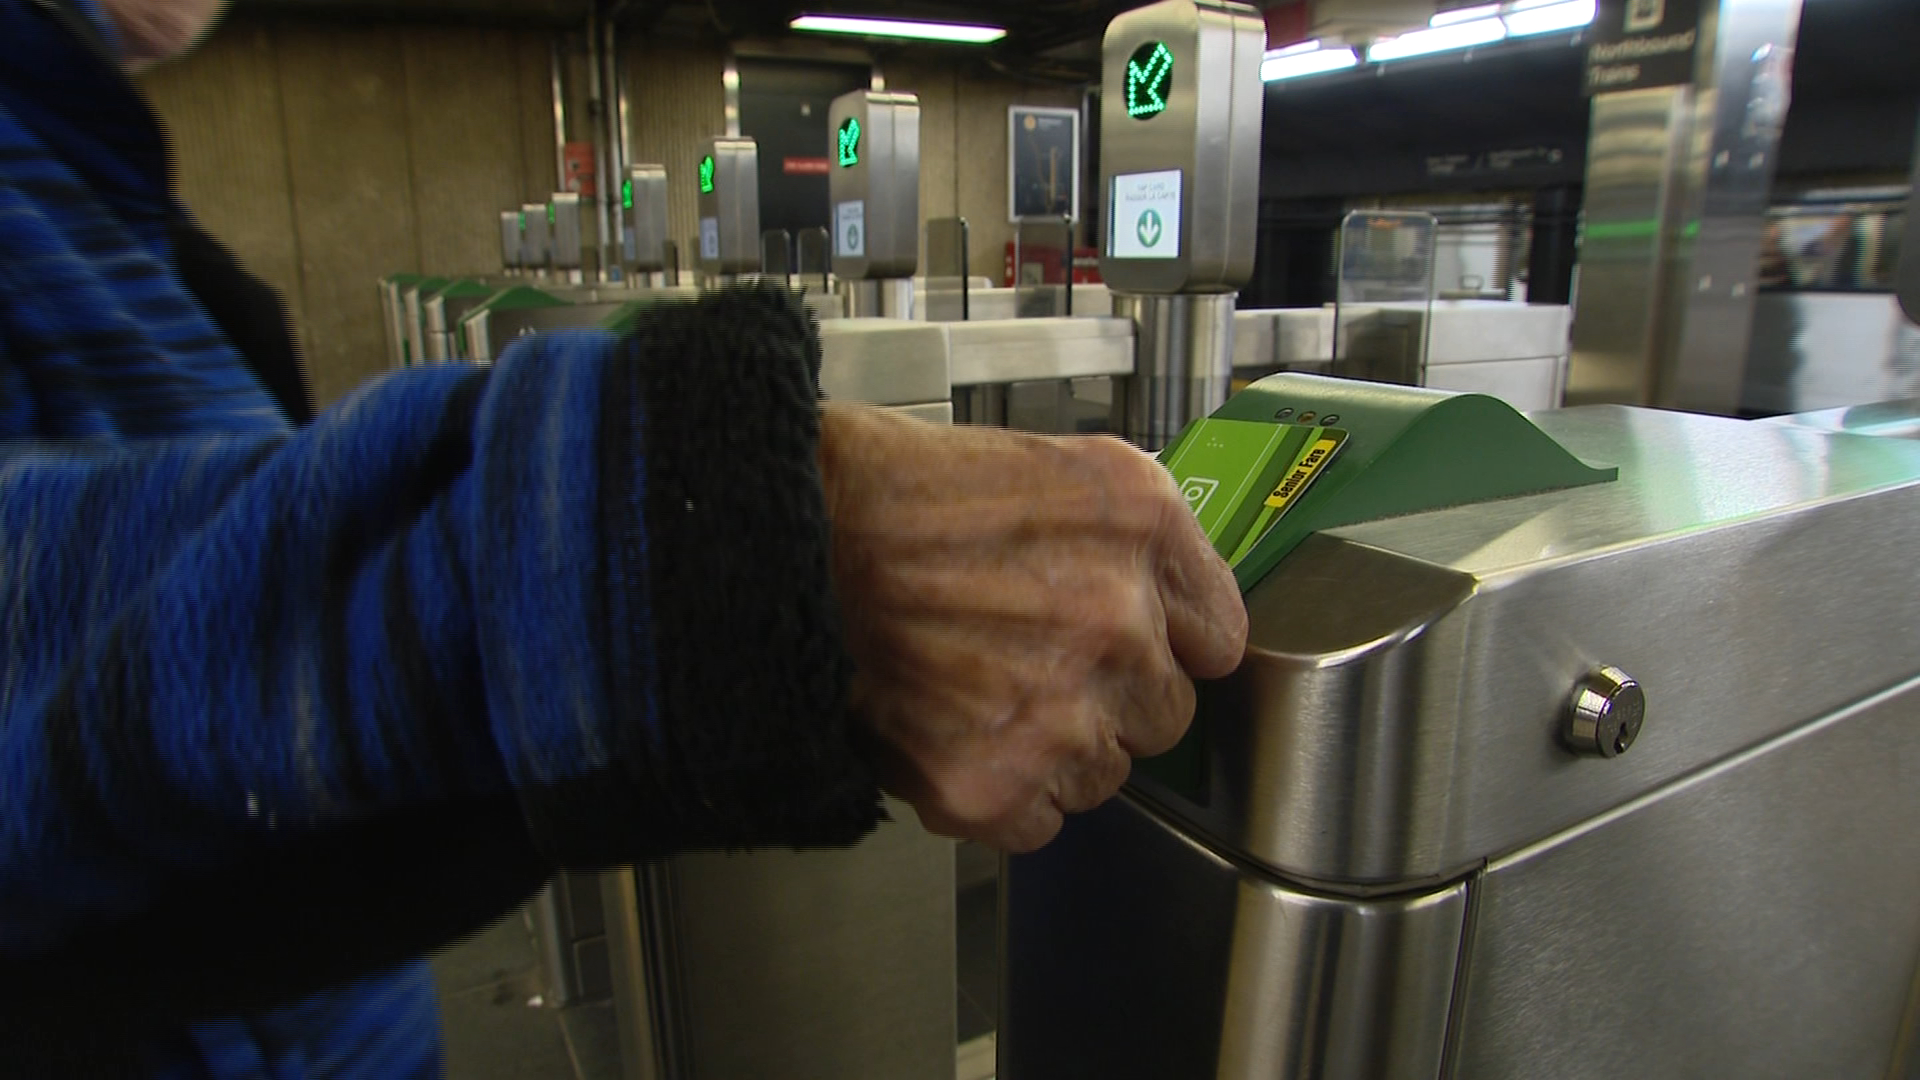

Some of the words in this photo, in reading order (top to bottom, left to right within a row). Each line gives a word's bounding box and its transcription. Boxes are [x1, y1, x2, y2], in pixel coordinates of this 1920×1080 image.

[1588, 28, 1696, 60] Northbound
[1588, 64, 1641, 86] Trains
[1273, 469, 1307, 498] Senior
[1298, 449, 1326, 468] Fare
